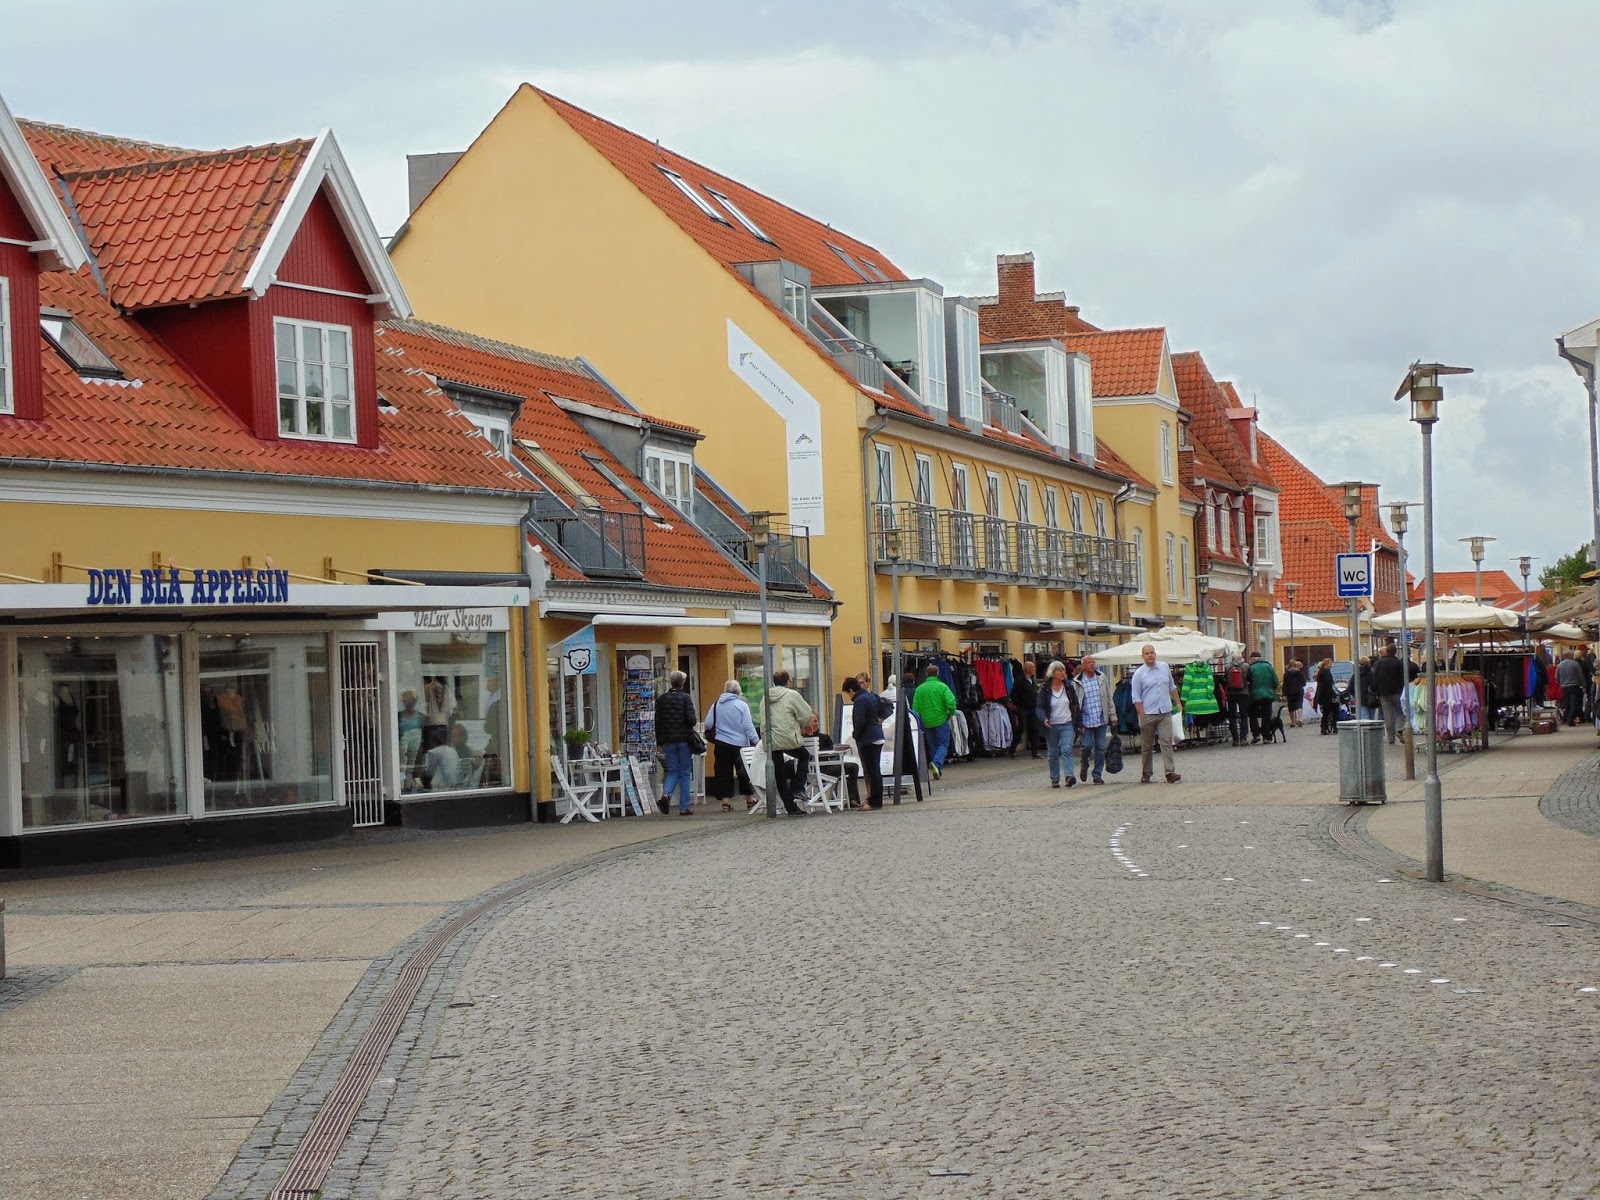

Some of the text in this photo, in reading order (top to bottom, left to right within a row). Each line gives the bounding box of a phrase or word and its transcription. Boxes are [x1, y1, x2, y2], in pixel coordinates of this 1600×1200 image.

[87, 569, 131, 604] DEN
[191, 568, 289, 603] APPELSIN
[1343, 570, 1366, 582] WC
[453, 608, 493, 630] Skagen
